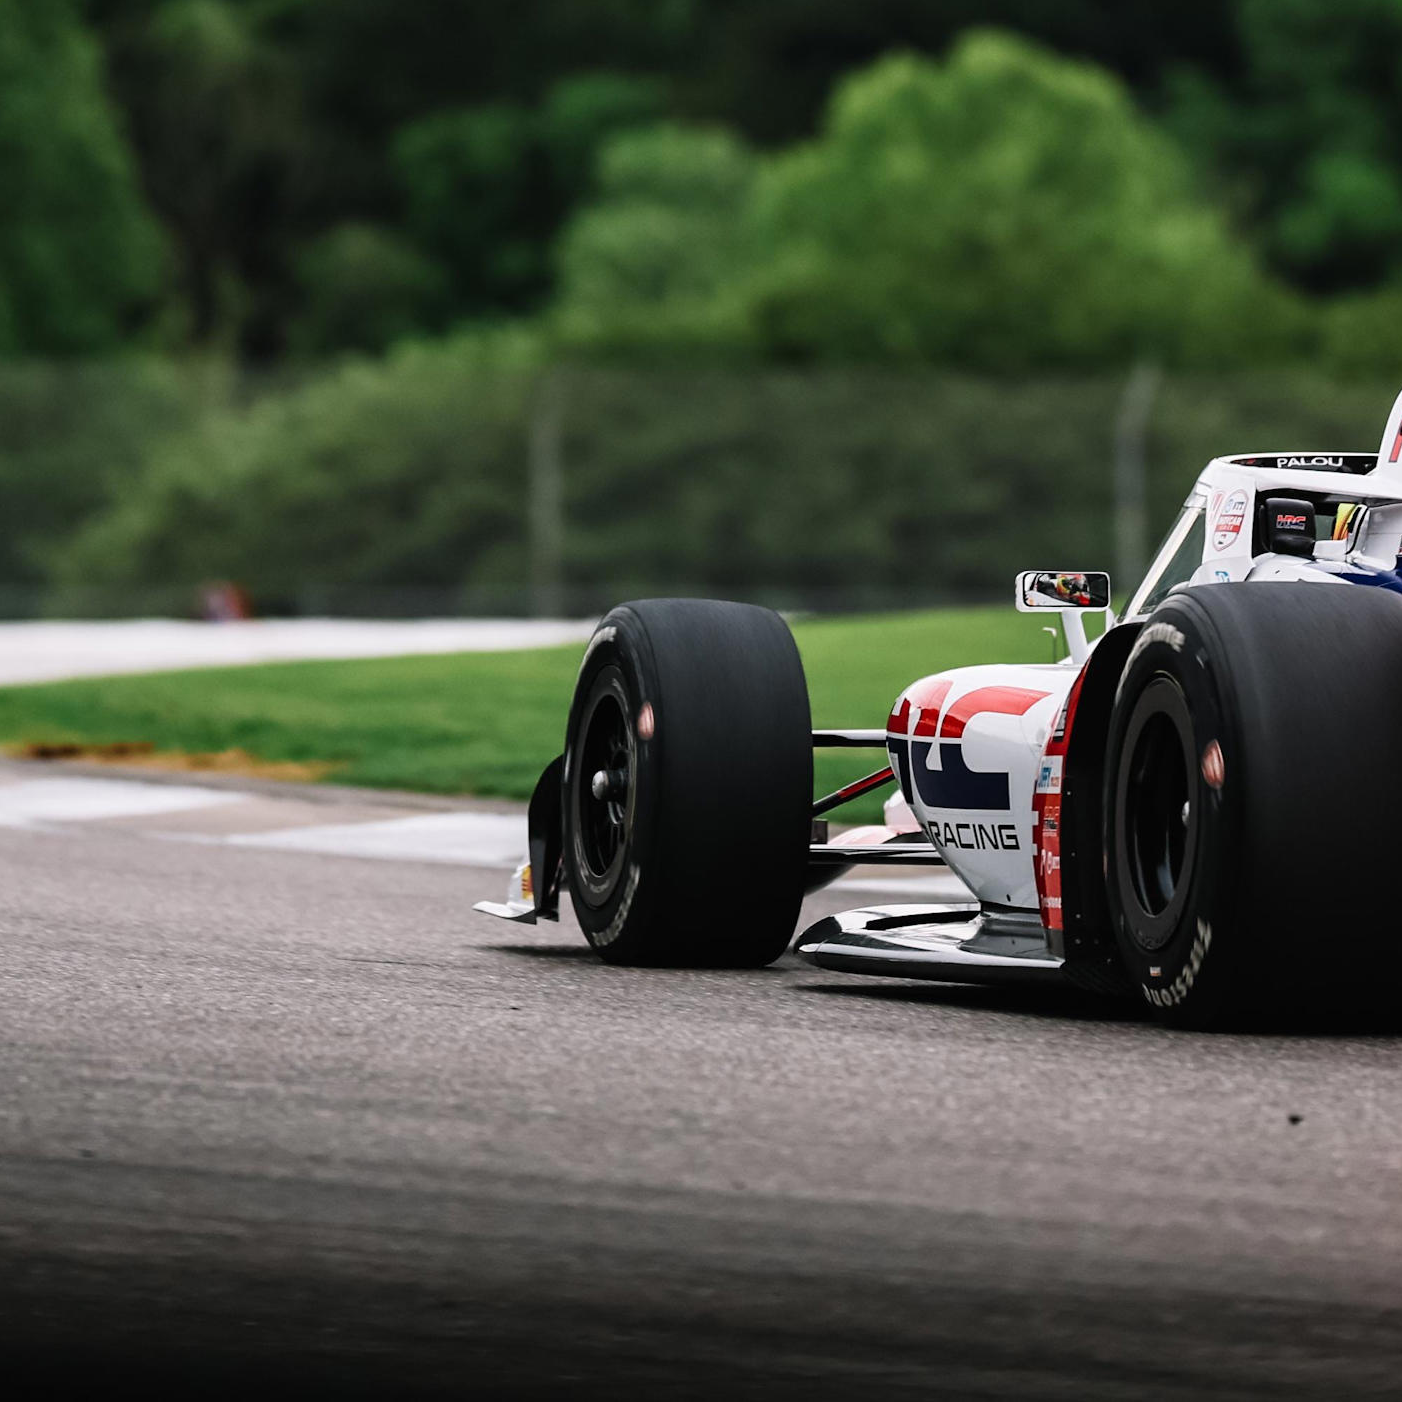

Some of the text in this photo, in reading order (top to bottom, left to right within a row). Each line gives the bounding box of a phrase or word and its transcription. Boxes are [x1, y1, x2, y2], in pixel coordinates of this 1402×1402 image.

[1277, 456, 1343, 468] PALOU
[1276, 514, 1307, 531] HRC
[926, 820, 1020, 850] RACING
